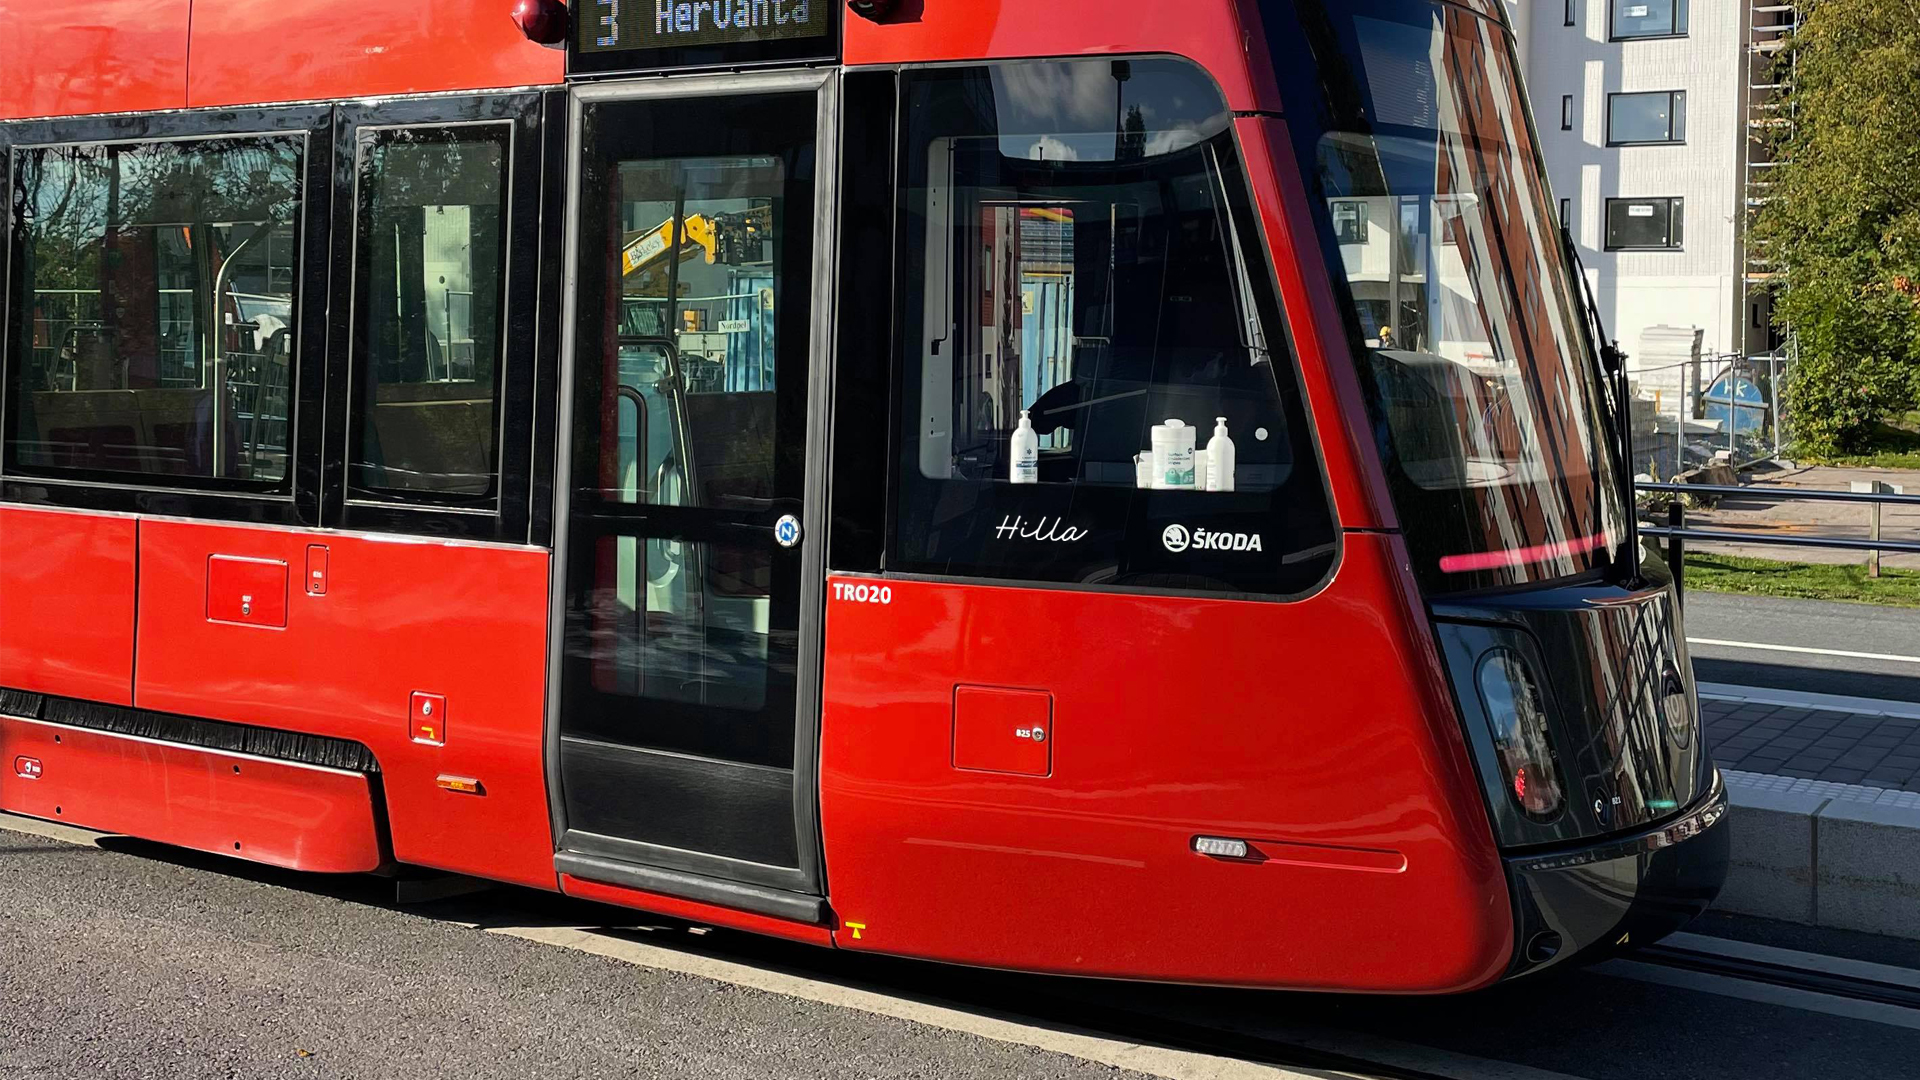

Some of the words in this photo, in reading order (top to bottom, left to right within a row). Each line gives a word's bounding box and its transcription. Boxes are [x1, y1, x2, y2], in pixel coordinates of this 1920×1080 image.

[597, 0, 618, 46] 3
[656, 0, 809, 34] Hervanta
[996, 515, 1088, 541] Hilla
[1192, 528, 1262, 551] ŠKODA
